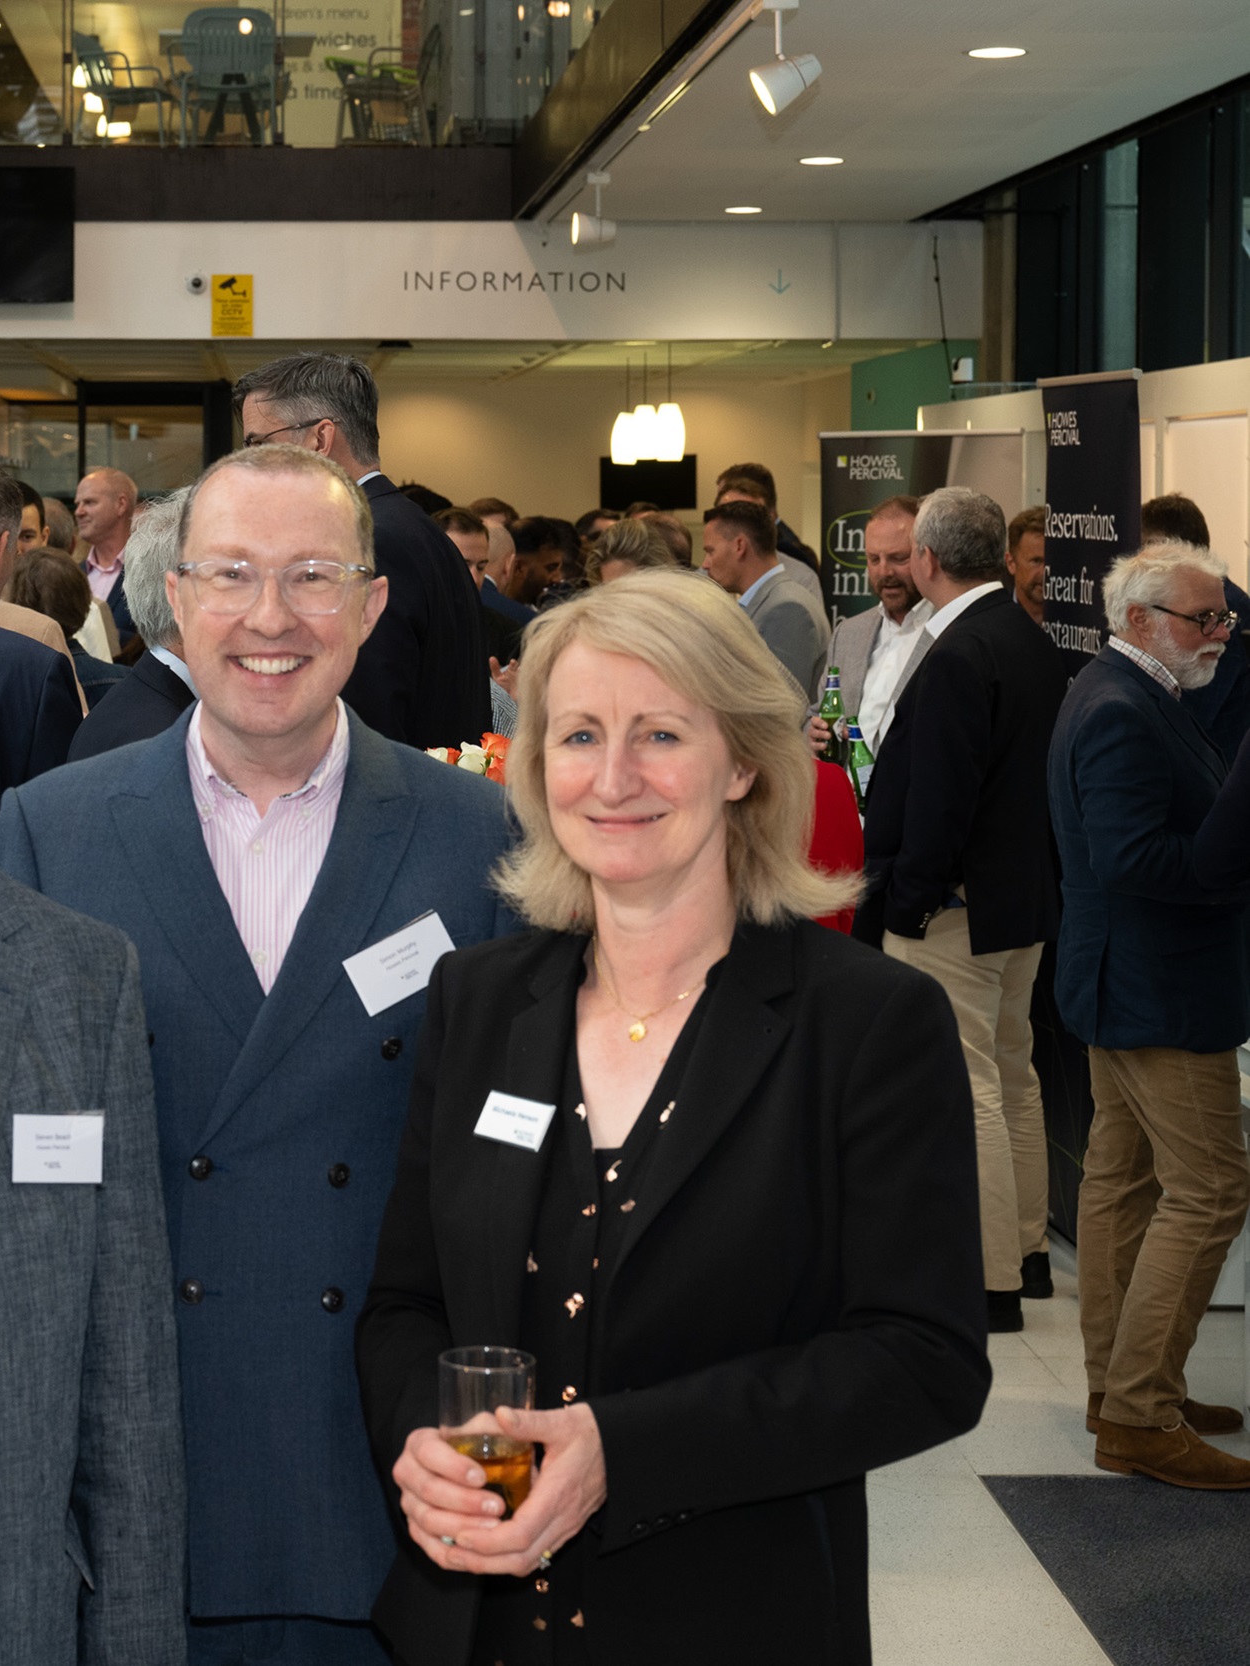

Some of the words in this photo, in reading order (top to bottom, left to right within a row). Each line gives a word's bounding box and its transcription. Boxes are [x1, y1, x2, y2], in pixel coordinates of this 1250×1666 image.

[403, 271, 626, 292] INFORMATION
[1052, 411, 1078, 428] HOWES
[1051, 428, 1081, 446] PERCIVAL
[851, 455, 897, 467] HOWES
[850, 467, 904, 480] PERCIVAL
[1044, 503, 1119, 542] Reservations.
[1043, 564, 1077, 602] Great
[1079, 566, 1095, 605] for
